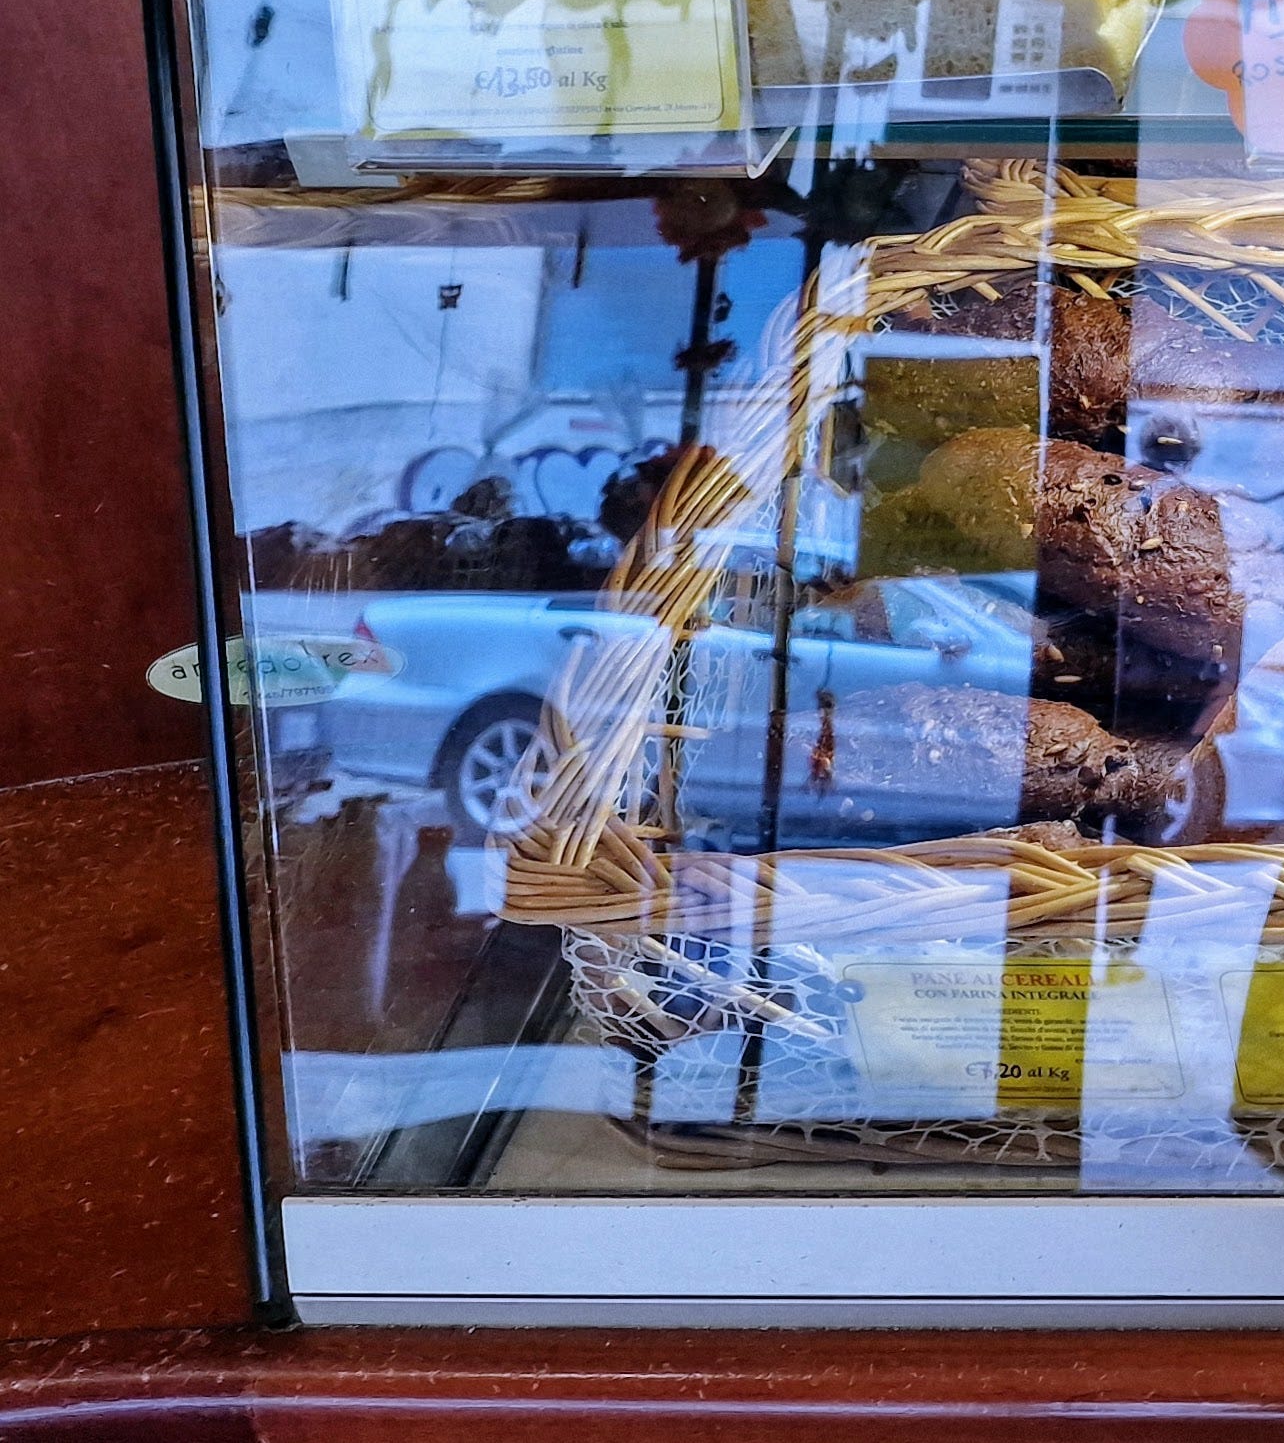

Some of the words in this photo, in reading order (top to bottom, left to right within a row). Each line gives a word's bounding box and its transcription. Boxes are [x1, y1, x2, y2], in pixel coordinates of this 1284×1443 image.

[559, 73, 576, 87] al
[582, 70, 607, 92] Kg
[911, 972, 968, 987] PANE
[914, 989, 948, 999] CON
[951, 989, 1007, 1000] FARINA
[1027, 1063, 1042, 1078] al
[1047, 1063, 1070, 1082] Kg
